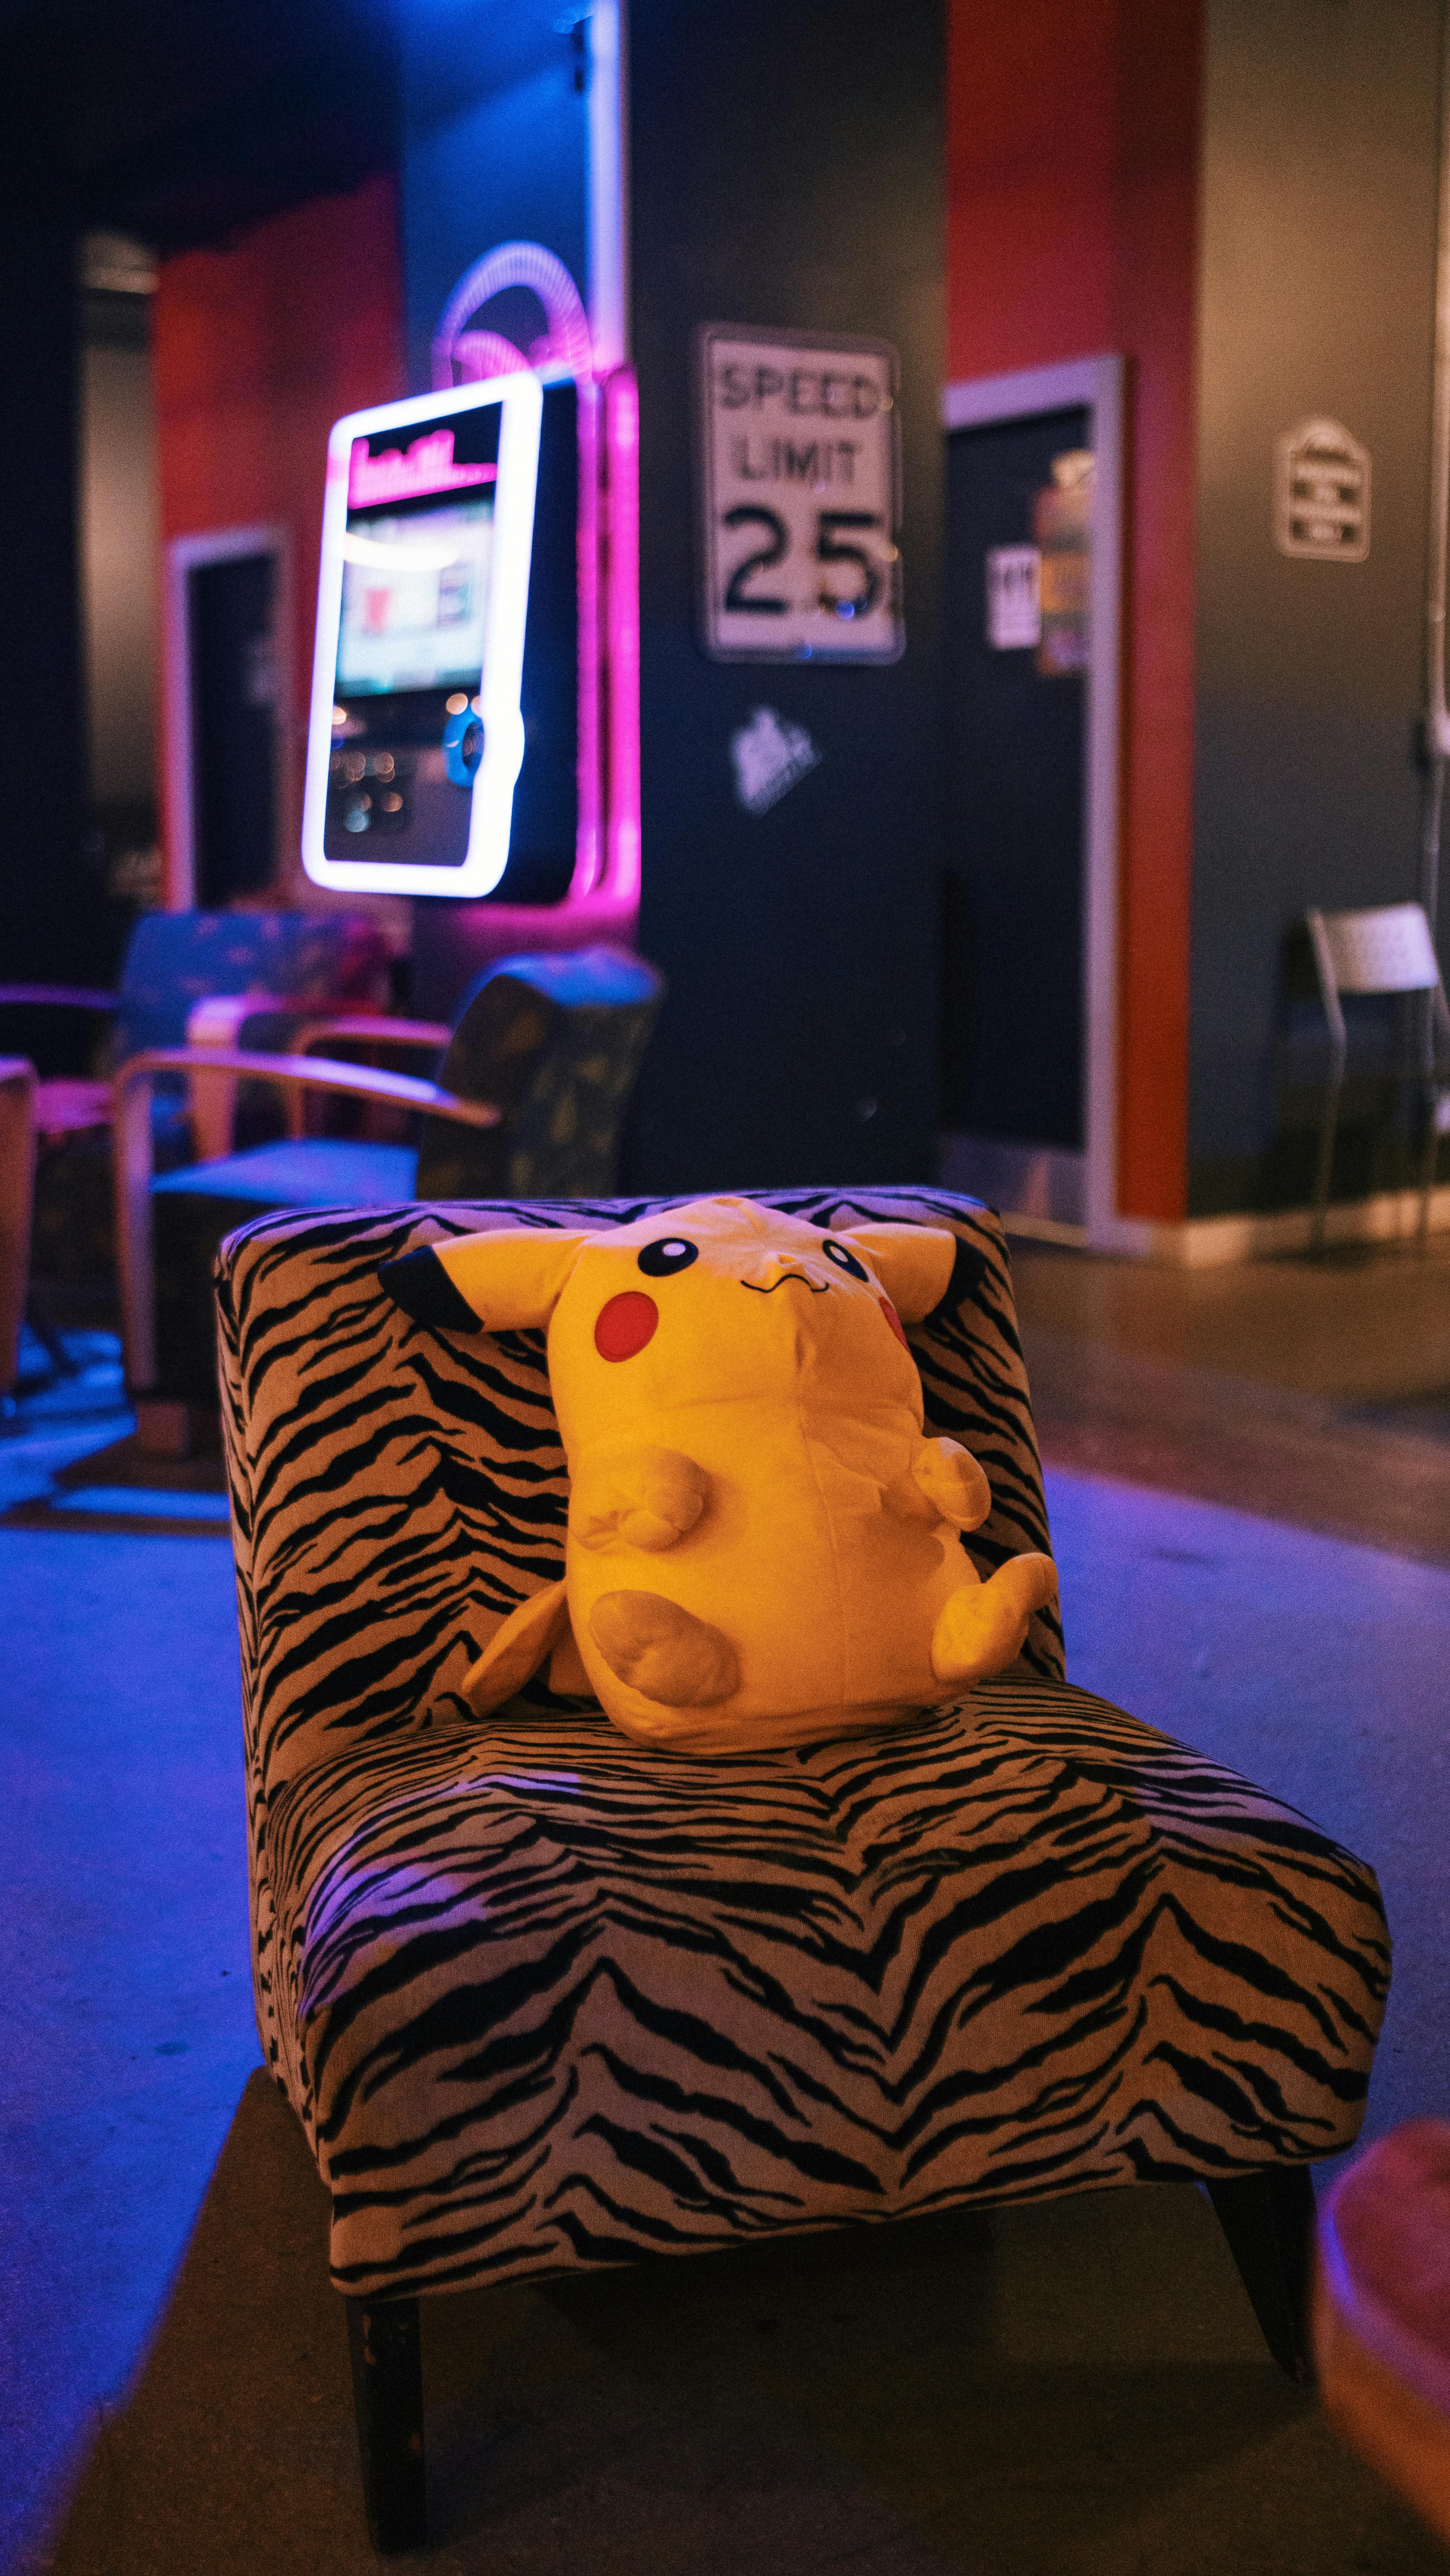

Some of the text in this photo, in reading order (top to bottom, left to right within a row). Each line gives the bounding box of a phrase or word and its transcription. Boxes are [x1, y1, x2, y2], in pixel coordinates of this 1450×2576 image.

[719, 363, 881, 419] SPEED
[738, 436, 860, 482] LIMIT
[724, 505, 880, 616] 25
